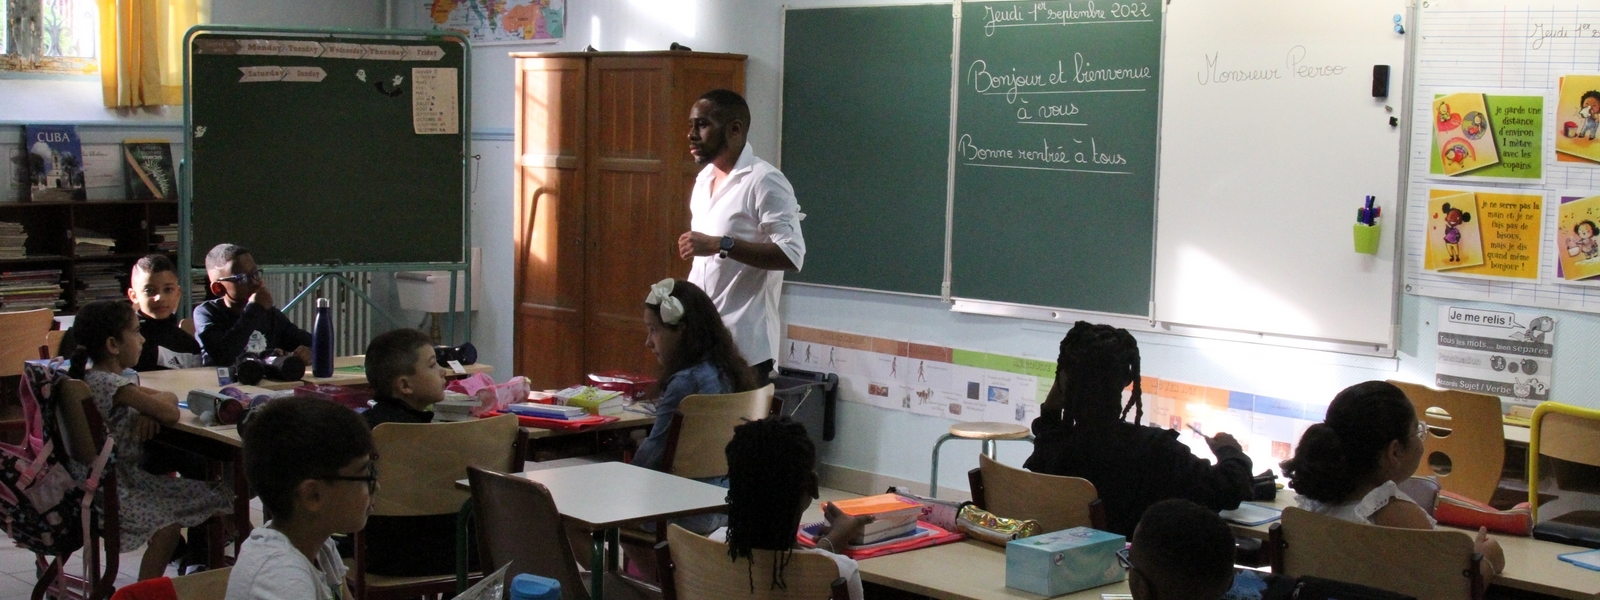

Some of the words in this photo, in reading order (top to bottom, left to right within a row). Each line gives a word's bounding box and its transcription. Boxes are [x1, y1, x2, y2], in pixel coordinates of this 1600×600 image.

[983, 5, 1024, 37] Jeudi
[1047, 1, 1106, 26] septembre
[1111, 2, 1150, 18] 2022
[1528, 23, 1568, 50] Jeudi
[247, 44, 281, 52] Monday
[287, 45, 318, 53] Tuesday
[369, 48, 404, 56] Thursday
[1197, 51, 1282, 86] Monsieur
[1286, 44, 1347, 78] Peeroo
[296, 70, 321, 78] Sunday
[967, 59, 1046, 104] Bonjour
[1049, 60, 1068, 85] et
[1072, 52, 1152, 83] bienvenue
[1016, 98, 1033, 120] à
[1038, 102, 1079, 119] vous
[1495, 106, 1502, 116] je
[1504, 106, 1525, 116] garde
[1528, 107, 1542, 115] une
[1502, 116, 1534, 126] distance
[37, 131, 71, 143] CUBA
[1498, 126, 1534, 137] d'environ
[1509, 139, 1532, 147] mètre
[958, 133, 1013, 161] Bonne
[1017, 138, 1070, 163] rentrée
[1073, 138, 1088, 164] à
[1091, 137, 1127, 165] tous
[1502, 150, 1519, 158] avec
[1521, 149, 1532, 158] les
[1502, 161, 1532, 172] copains
[1481, 200, 1488, 209] je
[1519, 203, 1531, 212] pas
[1533, 201, 1540, 210] la
[1487, 211, 1505, 219] main
[1516, 212, 1523, 221] je
[1491, 220, 1504, 229] fais
[1506, 223, 1519, 231] pas
[1520, 222, 1528, 230] de
[1496, 230, 1522, 241] bisous,
[1490, 242, 1506, 250] mais
[1507, 243, 1515, 251] je
[1517, 243, 1528, 251] dis
[1486, 251, 1508, 261] quand
[1509, 252, 1530, 260] même
[1490, 260, 1520, 271] bonjour
[1450, 310, 1462, 321] Je
[1464, 313, 1480, 323] me
[1482, 314, 1505, 325] relis
[1439, 335, 1455, 345] Tous
[1456, 338, 1466, 346] les
[1496, 343, 1512, 351] bien
[1459, 380, 1480, 391] Sujet
[1486, 384, 1512, 395] Verbe
